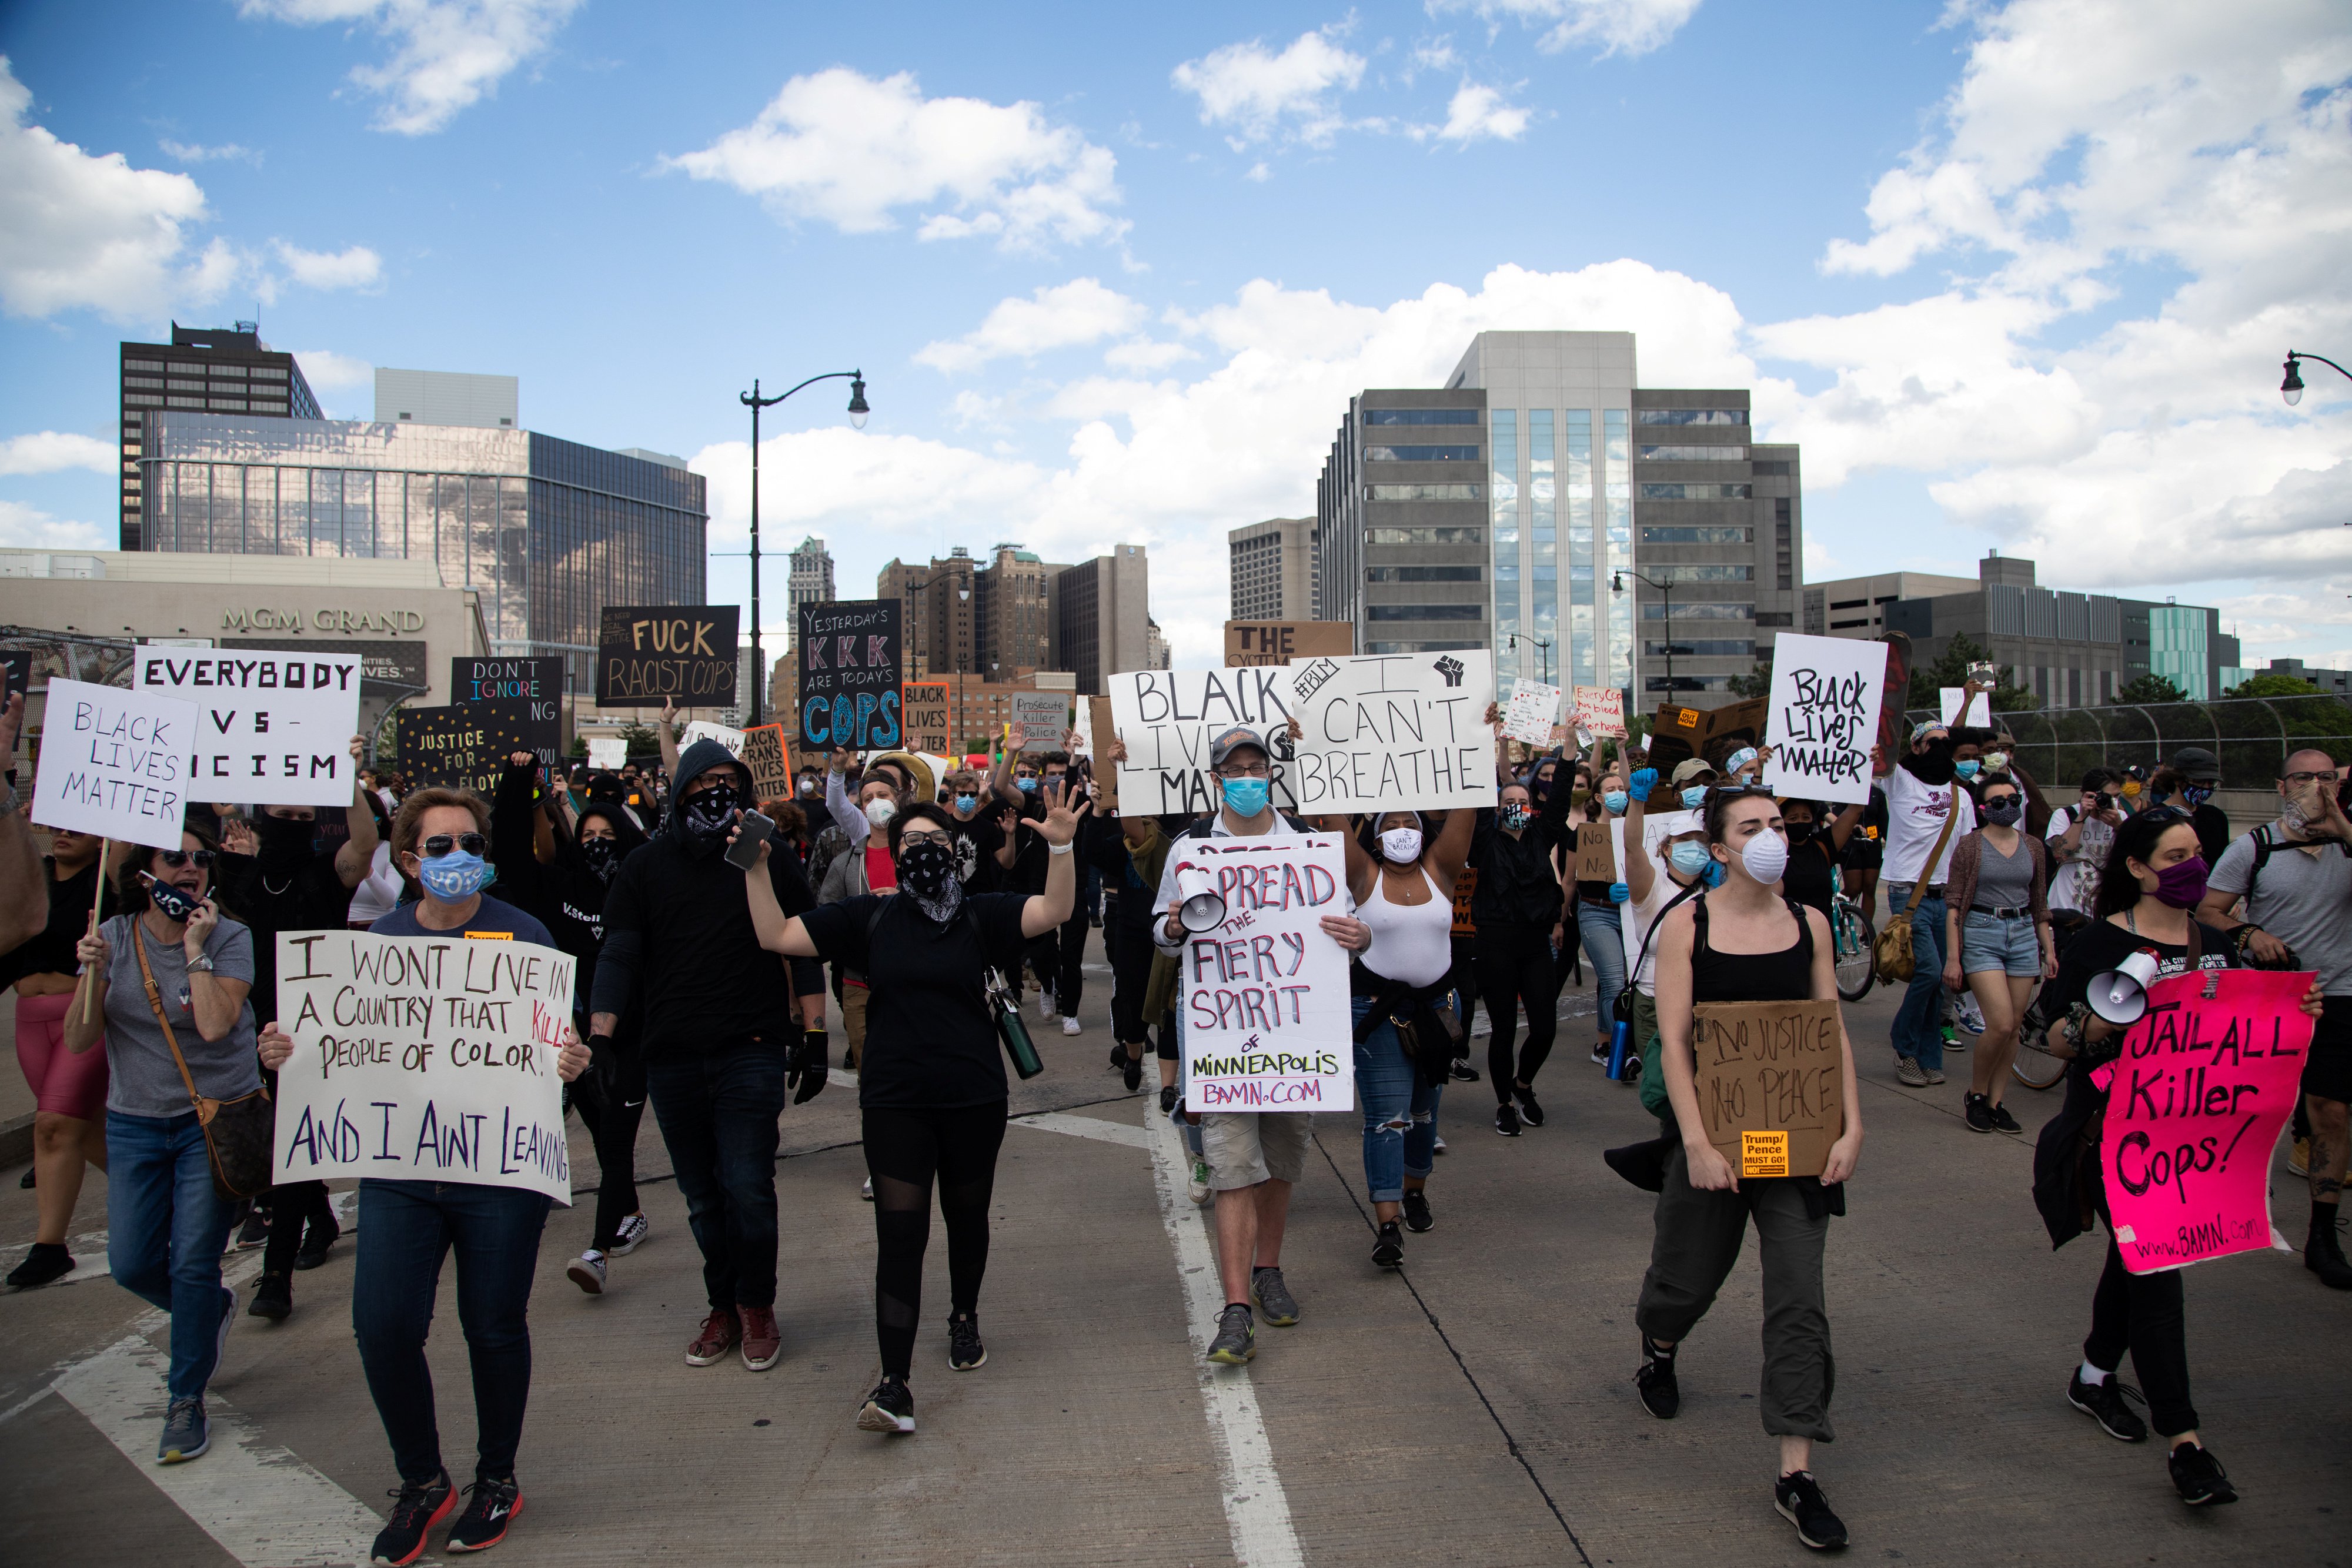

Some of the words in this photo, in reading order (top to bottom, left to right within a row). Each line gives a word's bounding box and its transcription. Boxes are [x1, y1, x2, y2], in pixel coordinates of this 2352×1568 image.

[221, 609, 304, 631] MGM
[313, 609, 425, 633] GRAND
[804, 609, 888, 634] YESTERDAY'S
[633, 619, 715, 657] FUCK
[1234, 627, 1295, 654] THE
[145, 658, 354, 690] EVERYBODY
[473, 660, 539, 678] DON'T
[608, 658, 690, 697] RACIST
[691, 660, 734, 694] COPS
[806, 675, 832, 692] ARE
[841, 668, 894, 686] TODAY'S
[1295, 657, 1340, 698] #BLM
[1349, 656, 1419, 696] I
[470, 680, 540, 700] IGNORE
[905, 687, 944, 703] BLACK
[1135, 668, 1292, 724] BLACK
[1577, 687, 1604, 703] Every
[1605, 689, 1622, 703] Cop
[1017, 698, 1064, 711] Prosecute
[1023, 712, 1055, 723] Killer
[1577, 700, 1591, 708] has
[1593, 703, 1621, 716] blood
[75, 702, 171, 746] BLACK
[804, 690, 900, 747] COPS
[906, 710, 946, 728] LIVES
[1025, 726, 1056, 737] Police
[1324, 697, 1469, 744] CAN'T
[1679, 717, 1696, 726] NOW
[1785, 706, 1865, 751] Lives
[419, 730, 485, 750] JUSTICE
[745, 730, 779, 747] LACK
[904, 735, 947, 752] MTTER
[90, 739, 179, 781] LIVES
[445, 751, 476, 770] FOR
[753, 760, 784, 781] IVES
[754, 779, 787, 797] ATTER
[1295, 747, 1485, 803] BREATHE
[62, 771, 177, 822] MATTER
[1220, 910, 1257, 937] THE
[285, 935, 332, 982] I
[351, 940, 450, 990] WONT
[465, 947, 541, 997] LIVE
[549, 961, 570, 1004] IN
[1191, 932, 1305, 983] FIERY
[293, 992, 323, 1034] A
[333, 985, 433, 1039] COUNTRY
[443, 997, 512, 1034] THAT
[531, 999, 570, 1048] KILLS
[1241, 1033, 1260, 1053] OF
[1712, 1019, 1748, 1060] NO
[1753, 1013, 1833, 1061] JUSTICE
[2131, 1001, 2214, 1059] JAIL
[2210, 1015, 2301, 1066] ALL
[319, 1034, 393, 1079] PEOPLE
[402, 1043, 434, 1073] OF
[450, 1037, 544, 1077] COLOR!
[1202, 1079, 1322, 1106] BAMN.COM
[1710, 1076, 1746, 1132] NO
[1758, 1065, 1835, 1129] PEACE
[2124, 1066, 2260, 1121] Killer
[285, 1097, 360, 1169] AND
[370, 1102, 401, 1161] I
[414, 1099, 488, 1173] AINT
[500, 1106, 567, 1183] LEAVING
[1744, 1134, 1784, 1145] Trump/
[1748, 1145, 1782, 1154] Pence
[1746, 1166, 1760, 1174] NO!
[2117, 1115, 2260, 1204] Cops!
